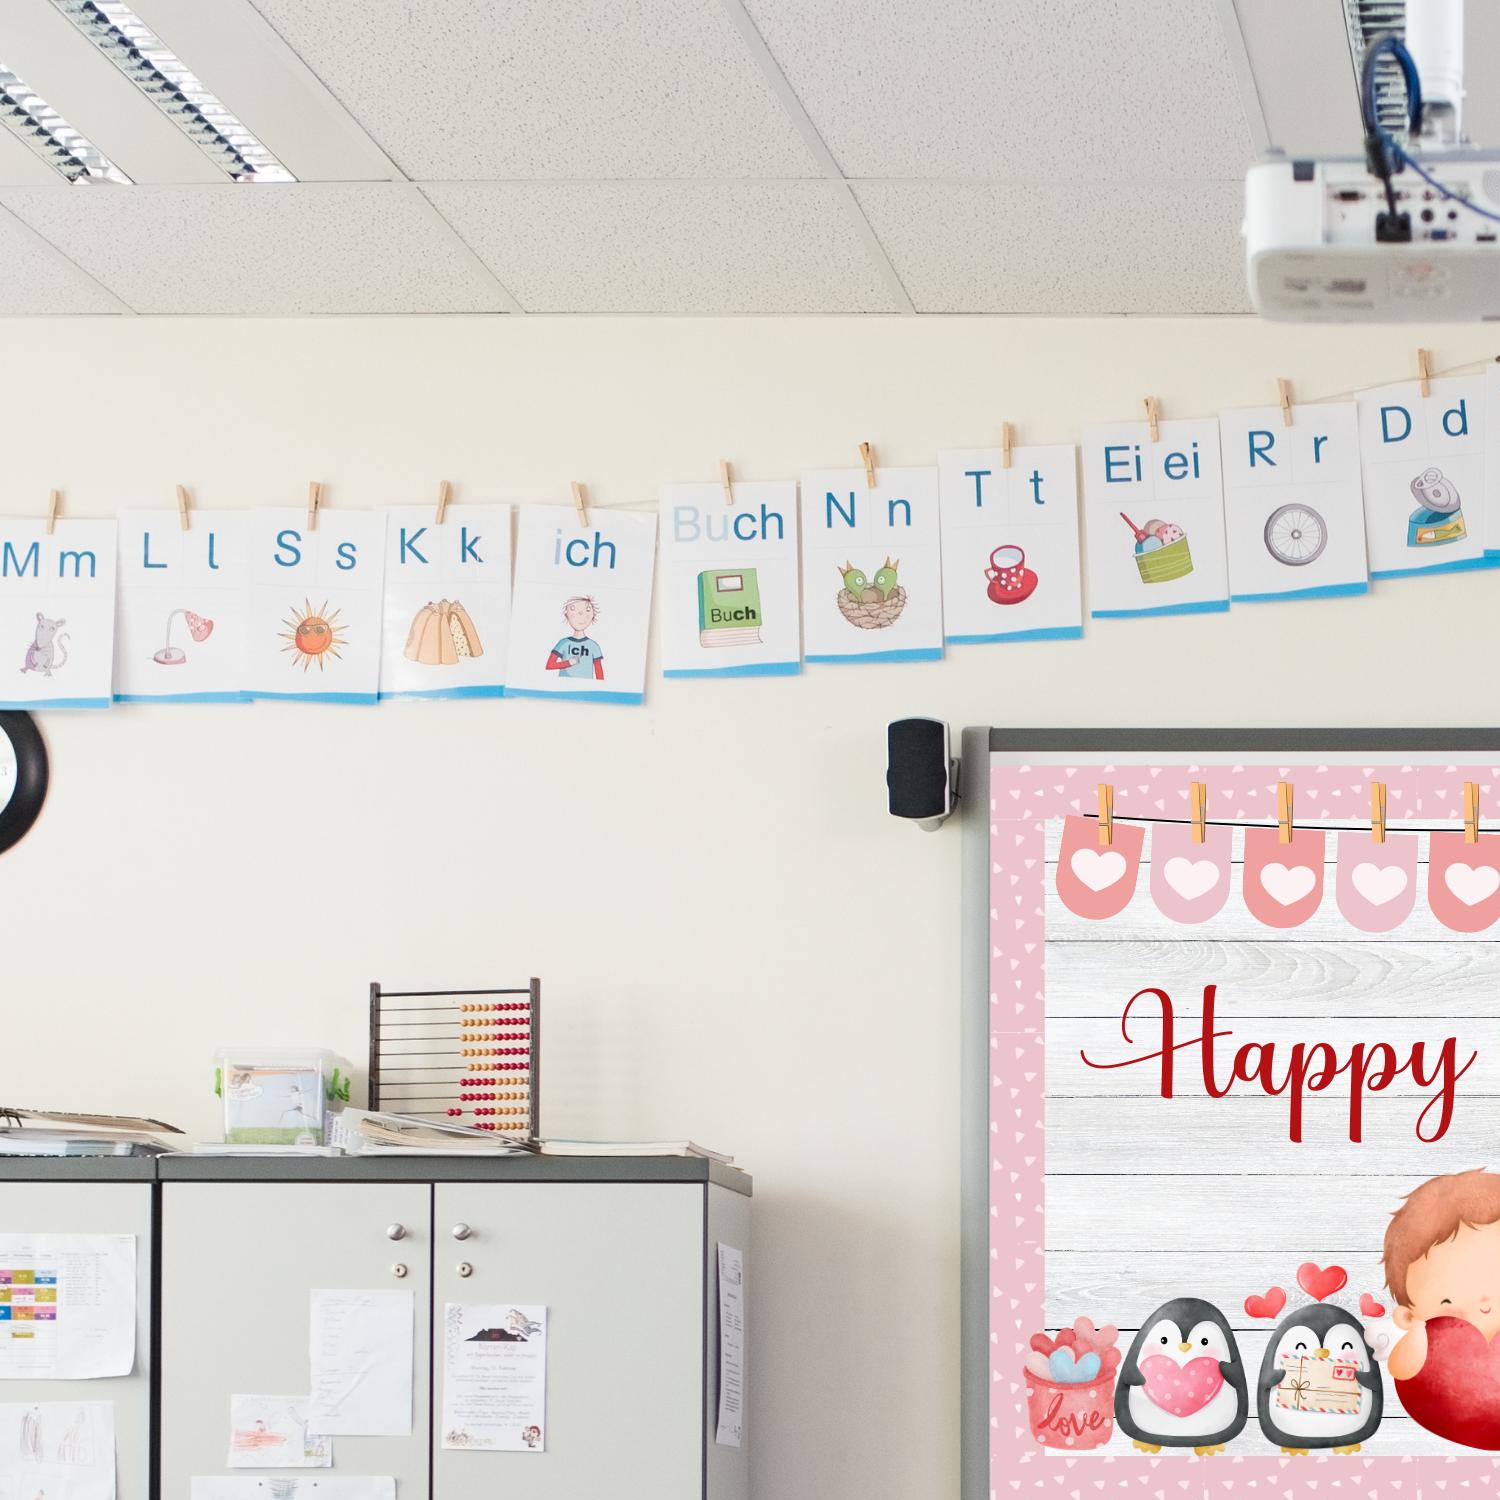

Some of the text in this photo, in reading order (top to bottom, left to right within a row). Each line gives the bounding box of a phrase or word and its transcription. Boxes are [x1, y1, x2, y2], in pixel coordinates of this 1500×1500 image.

[1380, 399, 1469, 444] D d
[1104, 442, 1201, 483] Ei ei
[1248, 430, 1328, 467] R r
[964, 470, 1046, 507] T t
[673, 503, 784, 542] Buch
[825, 491, 912, 528] N n
[2, 541, 96, 577] M m
[143, 532, 168, 569] L
[273, 529, 357, 570] S s
[399, 526, 484, 564] K k
[554, 527, 617, 569] ich
[710, 606, 757, 623] Buch
[1080, 984, 1478, 1144] Happy
[1037, 1392, 1106, 1437] love
